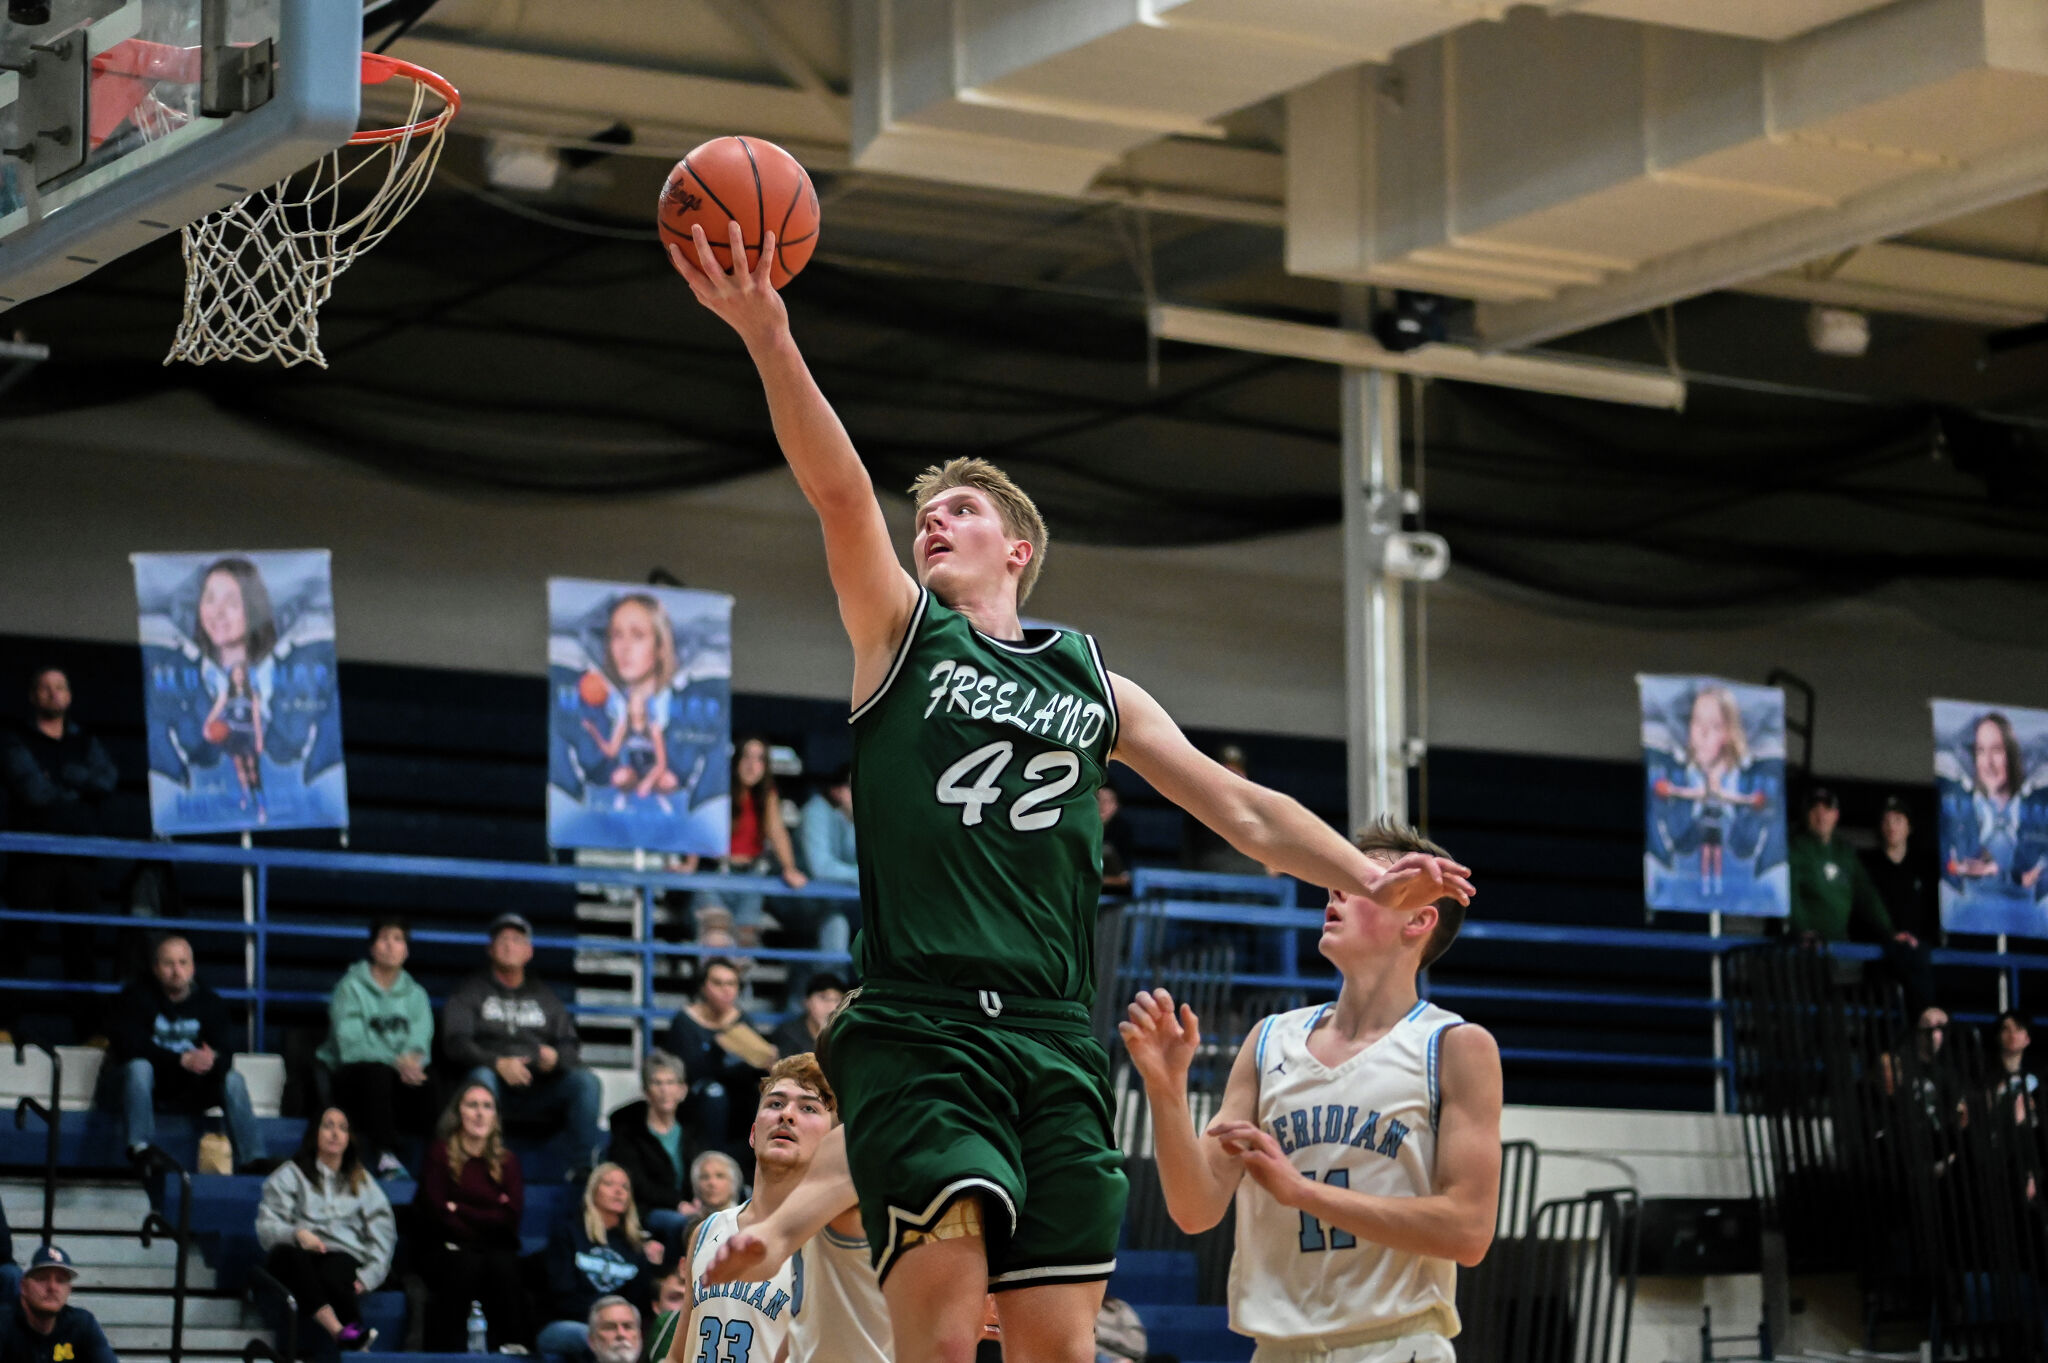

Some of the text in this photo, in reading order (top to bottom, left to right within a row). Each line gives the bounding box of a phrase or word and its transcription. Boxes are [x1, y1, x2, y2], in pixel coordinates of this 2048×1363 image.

[925, 660, 1106, 749] FREELAND
[936, 740, 1082, 832] 42
[1269, 1104, 1410, 1159] ERIDIAN
[697, 1315, 754, 1363] 33
